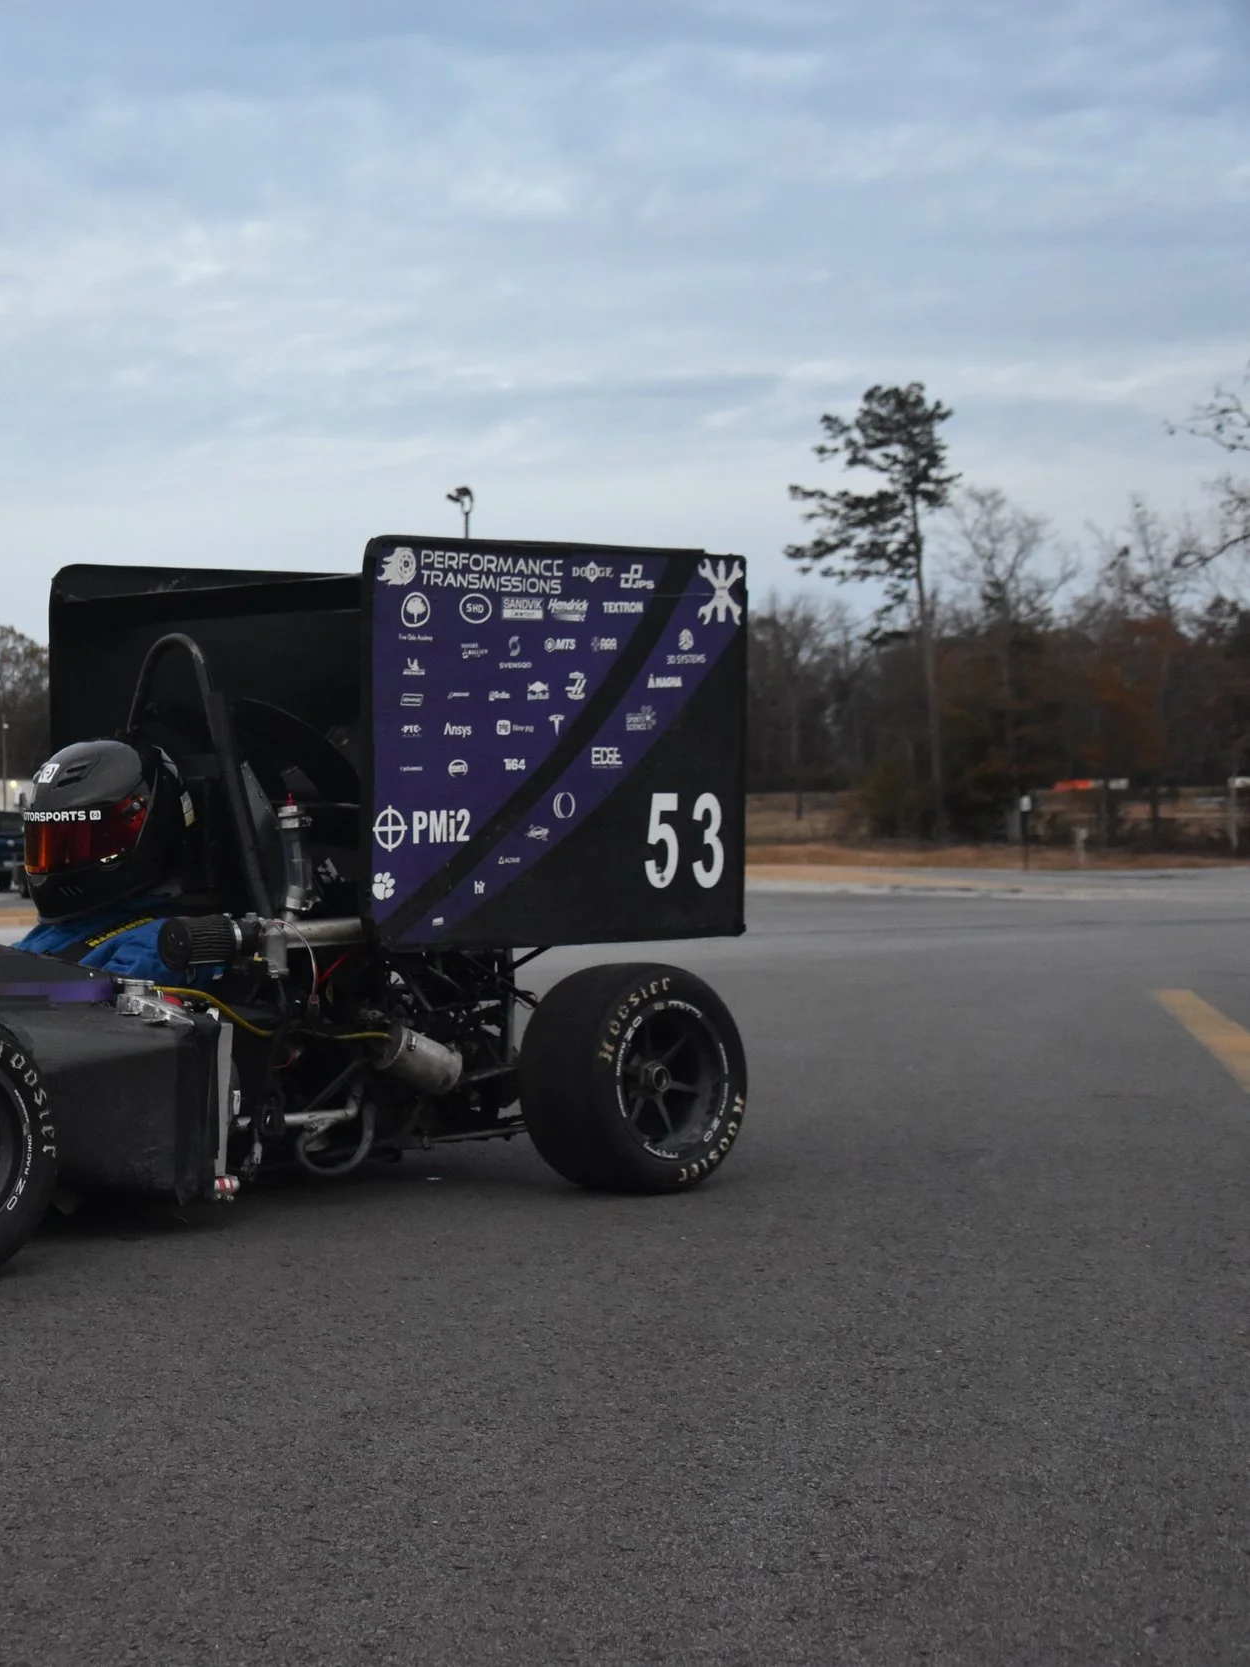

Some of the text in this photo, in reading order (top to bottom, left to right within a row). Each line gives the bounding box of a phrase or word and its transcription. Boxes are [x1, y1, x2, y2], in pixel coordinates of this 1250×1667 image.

[572, 563, 614, 580] DODGE
[421, 569, 562, 594] TRANSMISSIONS
[631, 579, 655, 590] JPS
[466, 603, 484, 614] SHD
[503, 598, 542, 610] SANDVIK
[547, 597, 589, 612] Hendrick
[602, 601, 643, 614] TEXTRON
[556, 638, 577, 650] MTS
[443, 722, 473, 738] Ansys
[23, 810, 86, 822] OTORSPORTS
[412, 808, 471, 844] PMi2
[644, 792, 725, 889] 53
